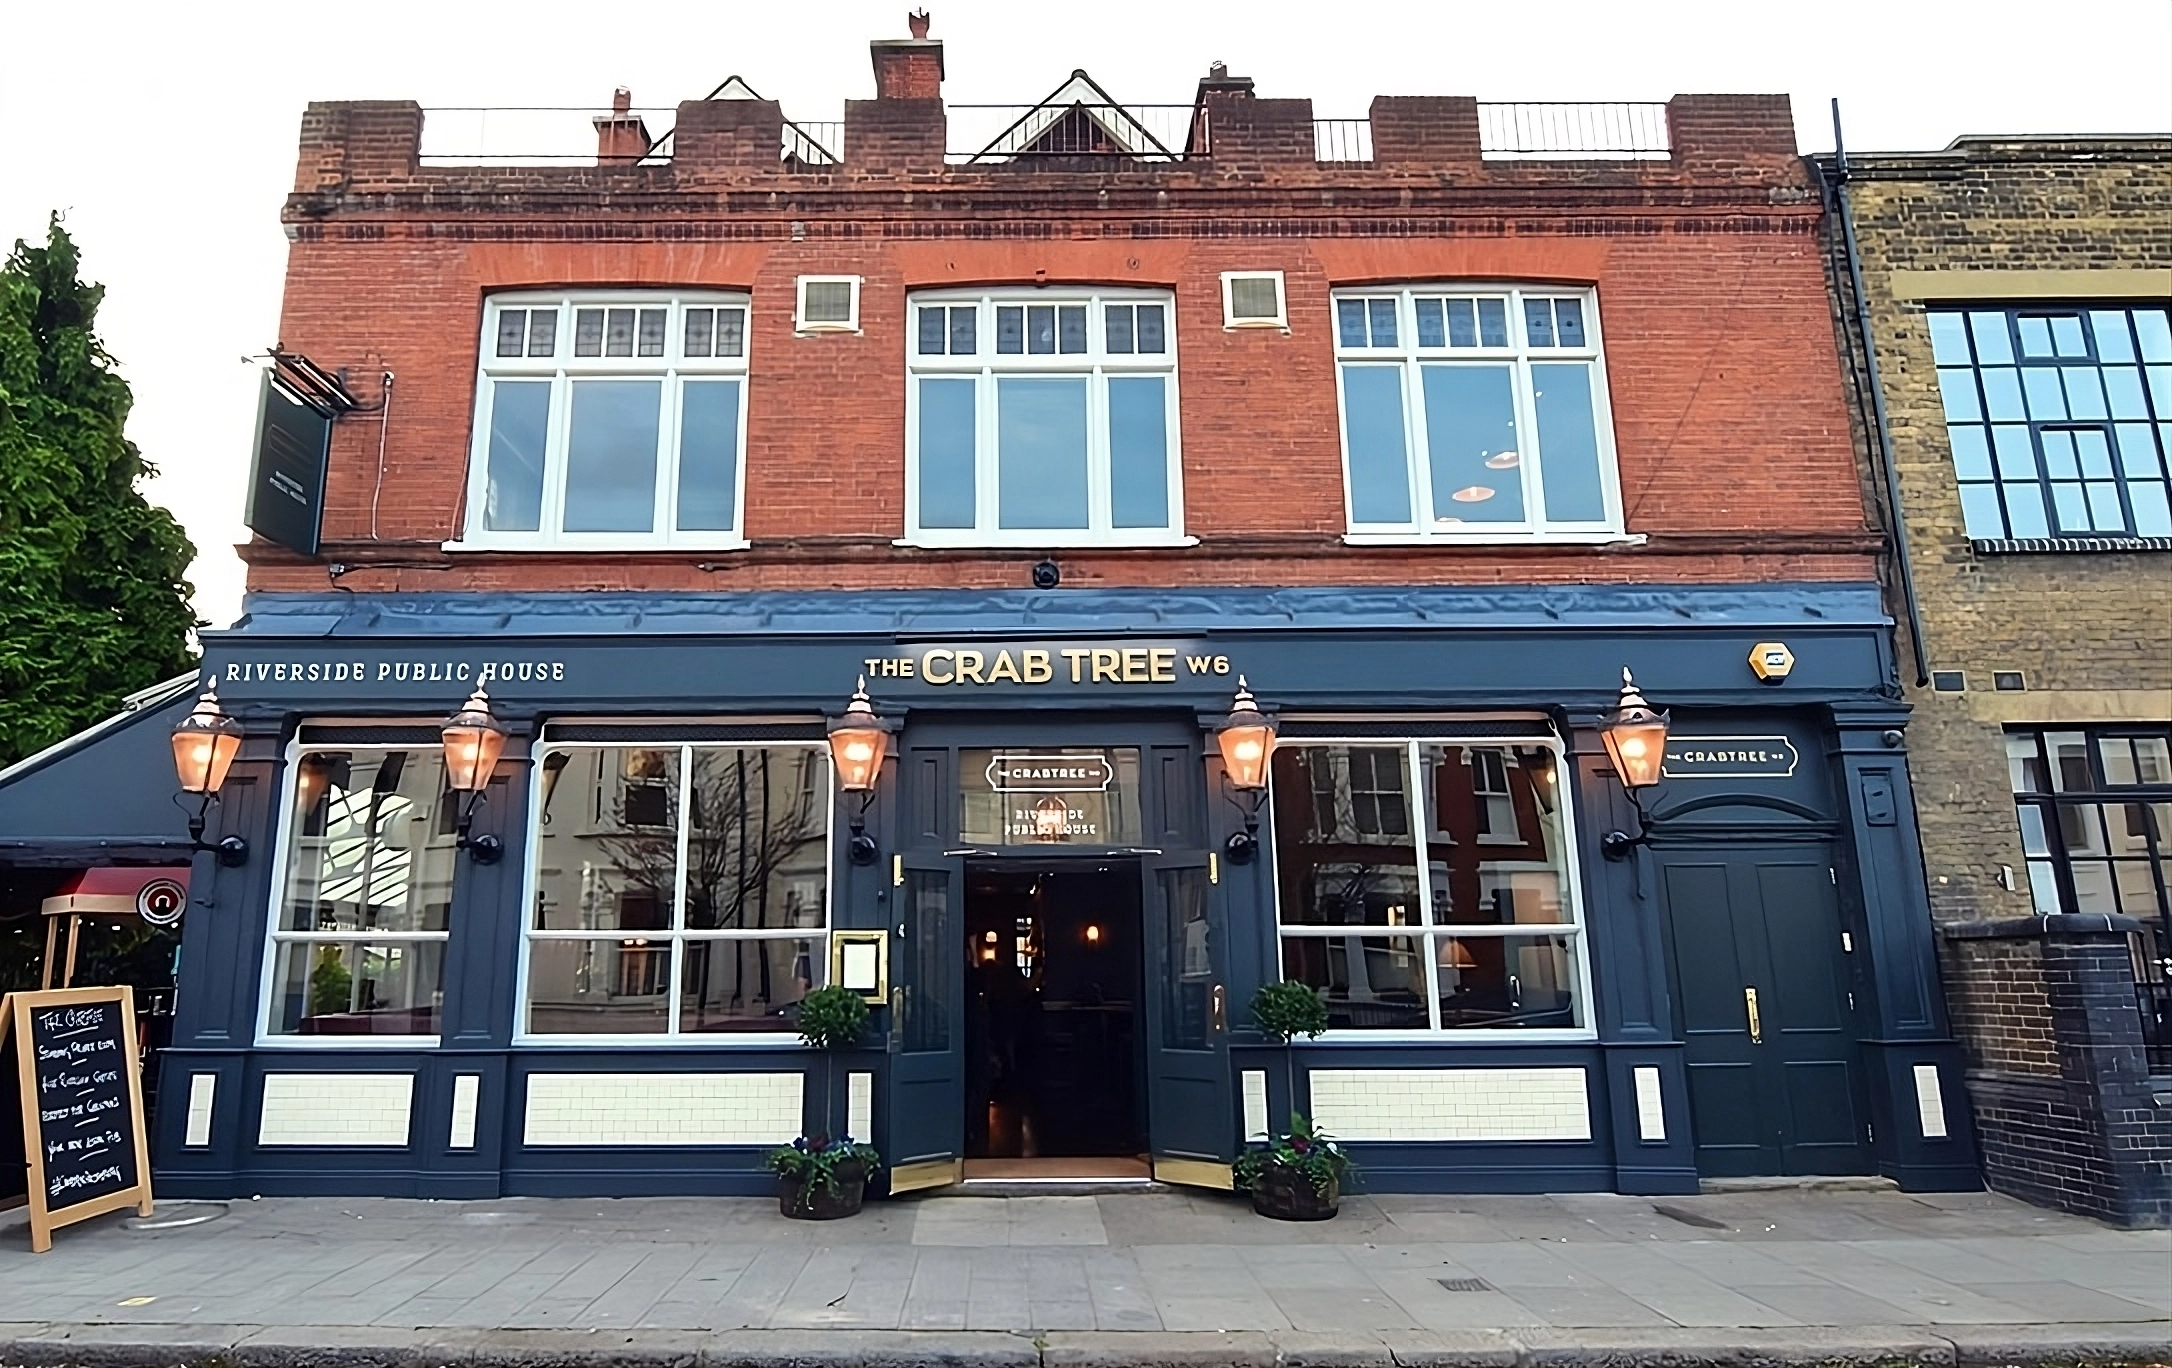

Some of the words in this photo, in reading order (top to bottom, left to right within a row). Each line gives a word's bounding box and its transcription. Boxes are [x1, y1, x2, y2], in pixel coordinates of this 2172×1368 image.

[225, 663, 365, 681] RIVERSIDE
[377, 663, 470, 681] PUBLIC
[482, 662, 565, 681] HOUSE
[864, 658, 914, 677] THE
[921, 648, 1053, 684] CRAB
[1060, 648, 1177, 682] TREE
[1185, 655, 1230, 674] W6
